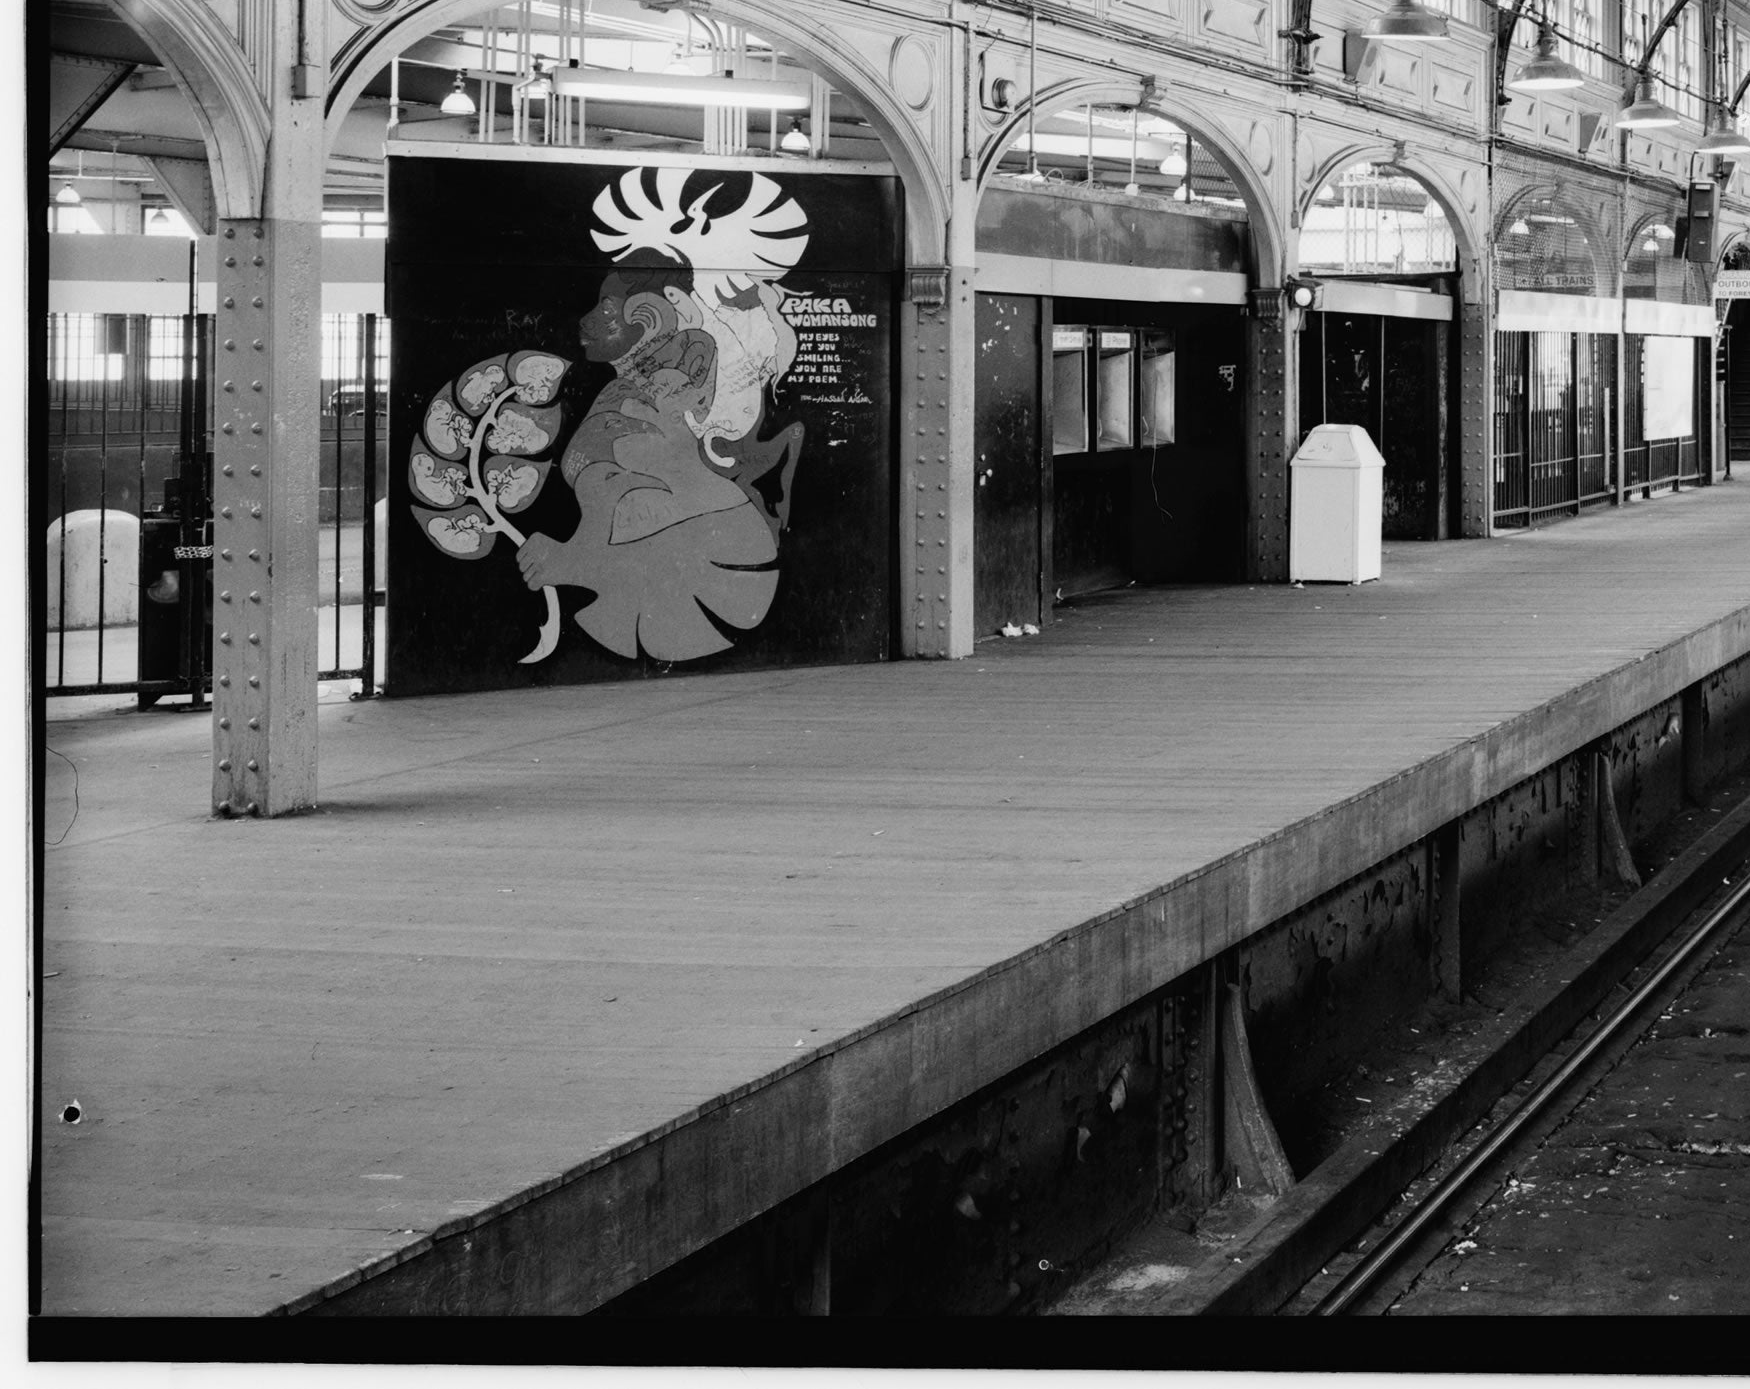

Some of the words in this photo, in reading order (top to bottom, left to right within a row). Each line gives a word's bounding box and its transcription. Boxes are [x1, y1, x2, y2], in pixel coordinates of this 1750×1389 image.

[1555, 275, 1594, 286] TRAINS
[780, 298, 852, 313] PAKA
[785, 314, 877, 328] WOMANSONG
[799, 333, 814, 342] MY
[815, 333, 840, 342] EYES
[800, 343, 813, 351] AT
[817, 343, 836, 351] YOU
[796, 354, 851, 363] SMILING...
[794, 364, 817, 373] YOU
[822, 364, 842, 373] ARE
[787, 375, 804, 383] MY
